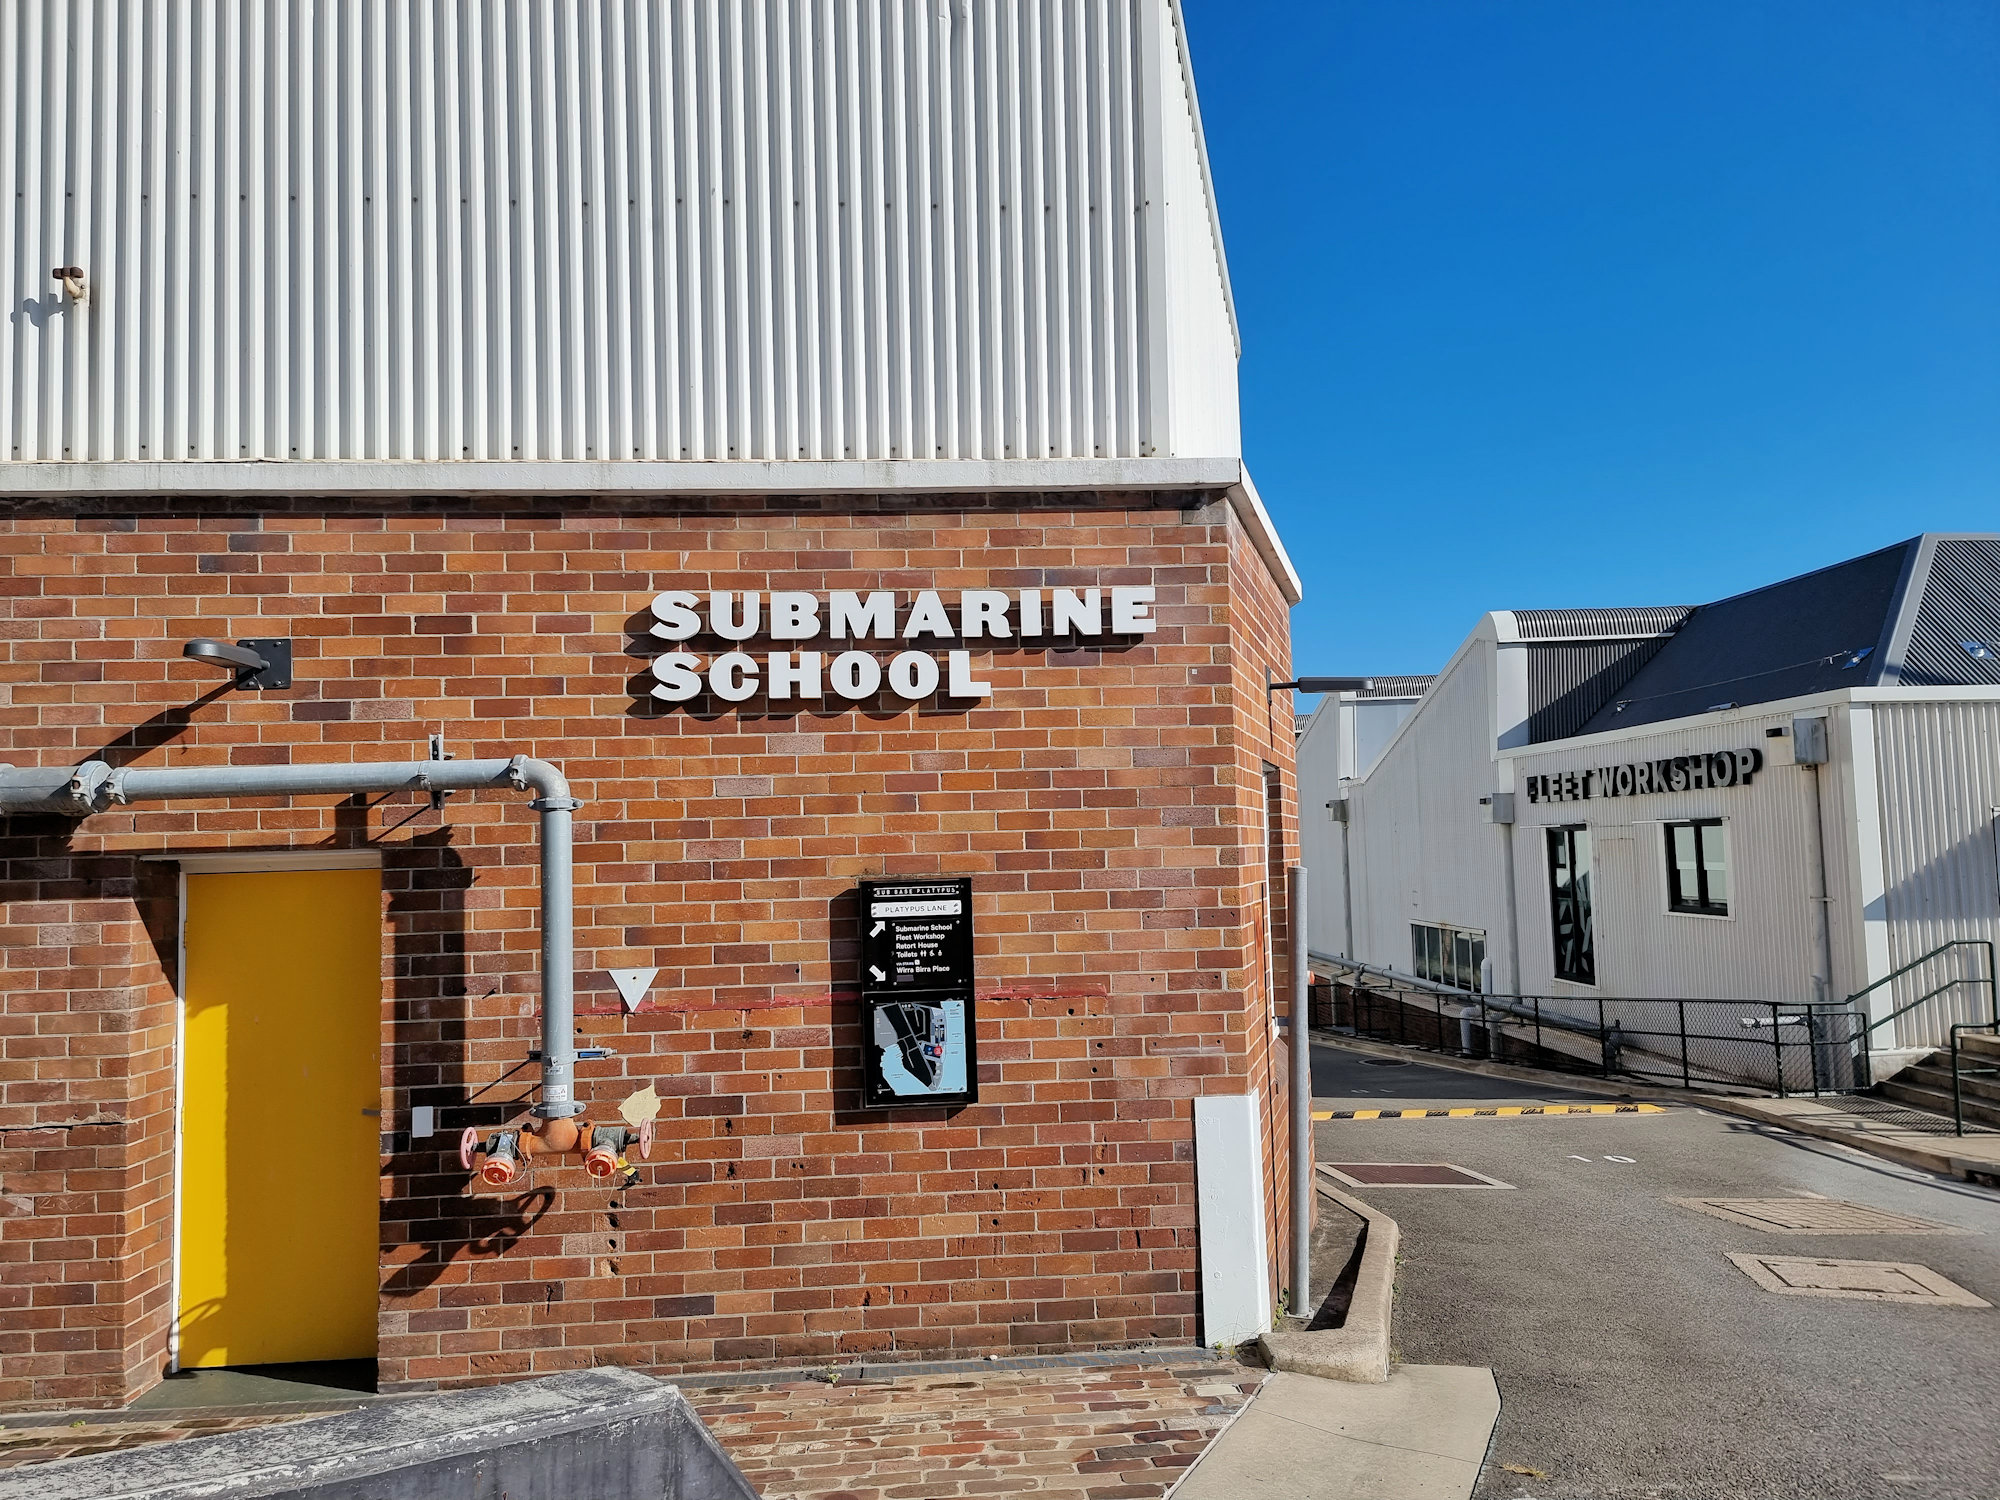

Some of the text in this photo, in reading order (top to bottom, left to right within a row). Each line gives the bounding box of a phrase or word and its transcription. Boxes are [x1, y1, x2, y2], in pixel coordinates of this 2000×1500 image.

[648, 587, 1157, 641] SUBMARINE
[648, 650, 992, 702] SCHOOL
[1527, 748, 1757, 803] FLEET WORKSHOP
[885, 904, 947, 913] PLATYPUS LANE
[896, 966, 915, 974] Wirra
[915, 965, 932, 973] Birra
[1565, 1154, 1637, 1163] 10
